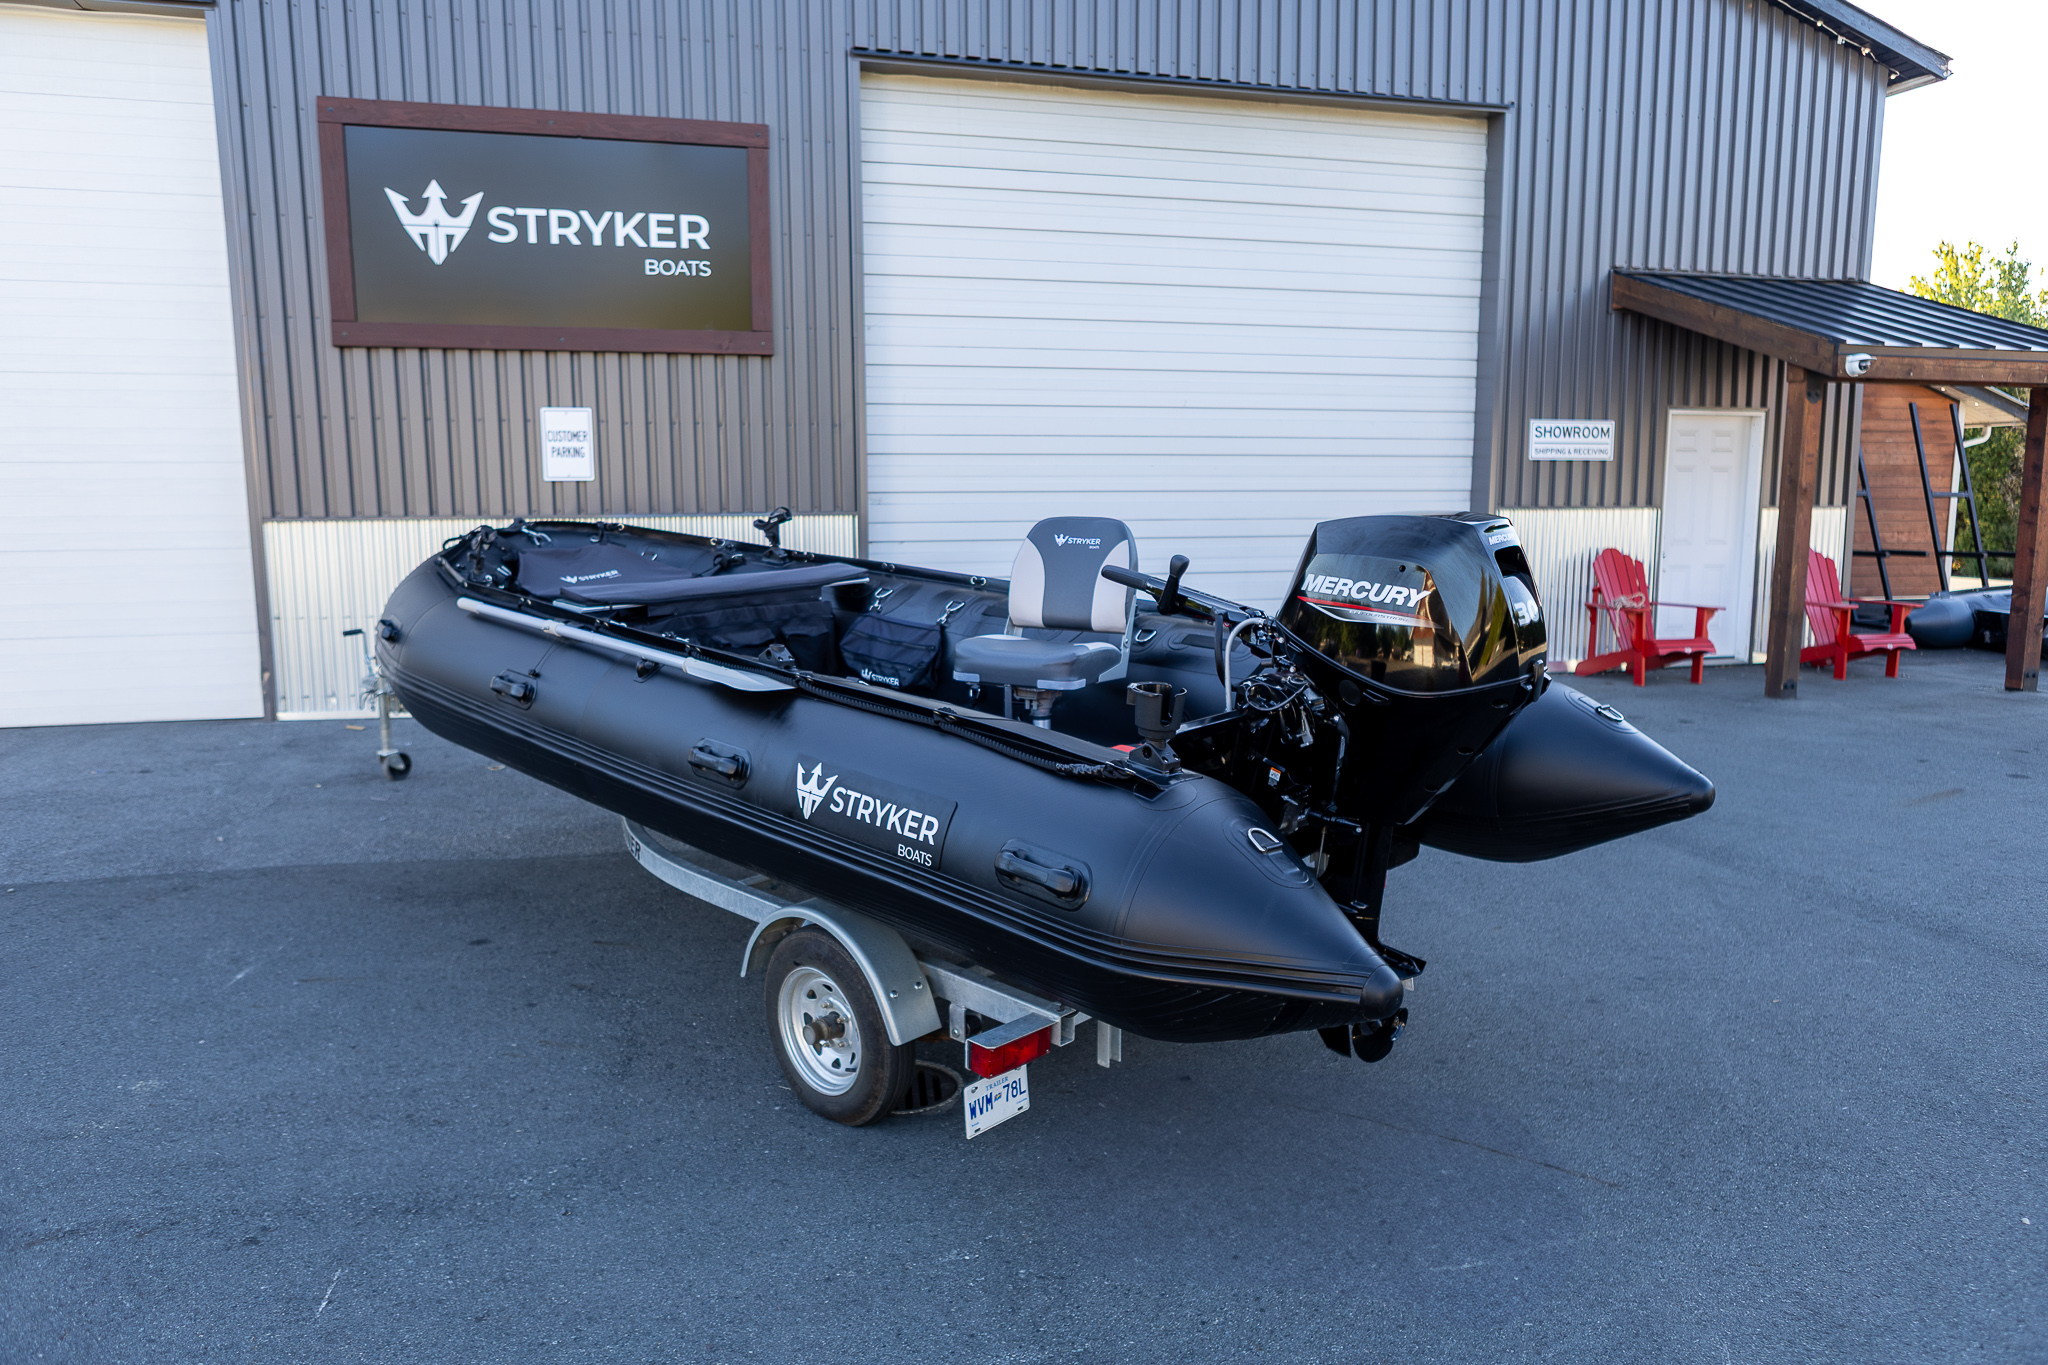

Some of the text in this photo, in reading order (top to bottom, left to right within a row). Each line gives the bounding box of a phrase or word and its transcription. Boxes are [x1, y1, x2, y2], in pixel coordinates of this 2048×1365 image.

[487, 205, 711, 250] STRYKER
[644, 258, 712, 277] BOATS
[547, 430, 588, 443] CUSTOMER
[1535, 425, 1611, 439] SHOWROOM
[551, 446, 585, 458] PARKING
[1534, 448, 1567, 456] SHIPPING
[1573, 448, 1609, 456] RECEIVING
[1067, 537, 1102, 545] STRYKER
[578, 569, 619, 582] STRYKER
[1301, 573, 1432, 608] MERCURY
[1514, 600, 1540, 627] 30
[871, 673, 900, 687] STRYKER
[829, 786, 939, 846] STRYKER
[897, 843, 932, 867] BOATS
[985, 1076, 1009, 1091] TRAILER
[968, 1077, 1027, 1121] WVM 78L
